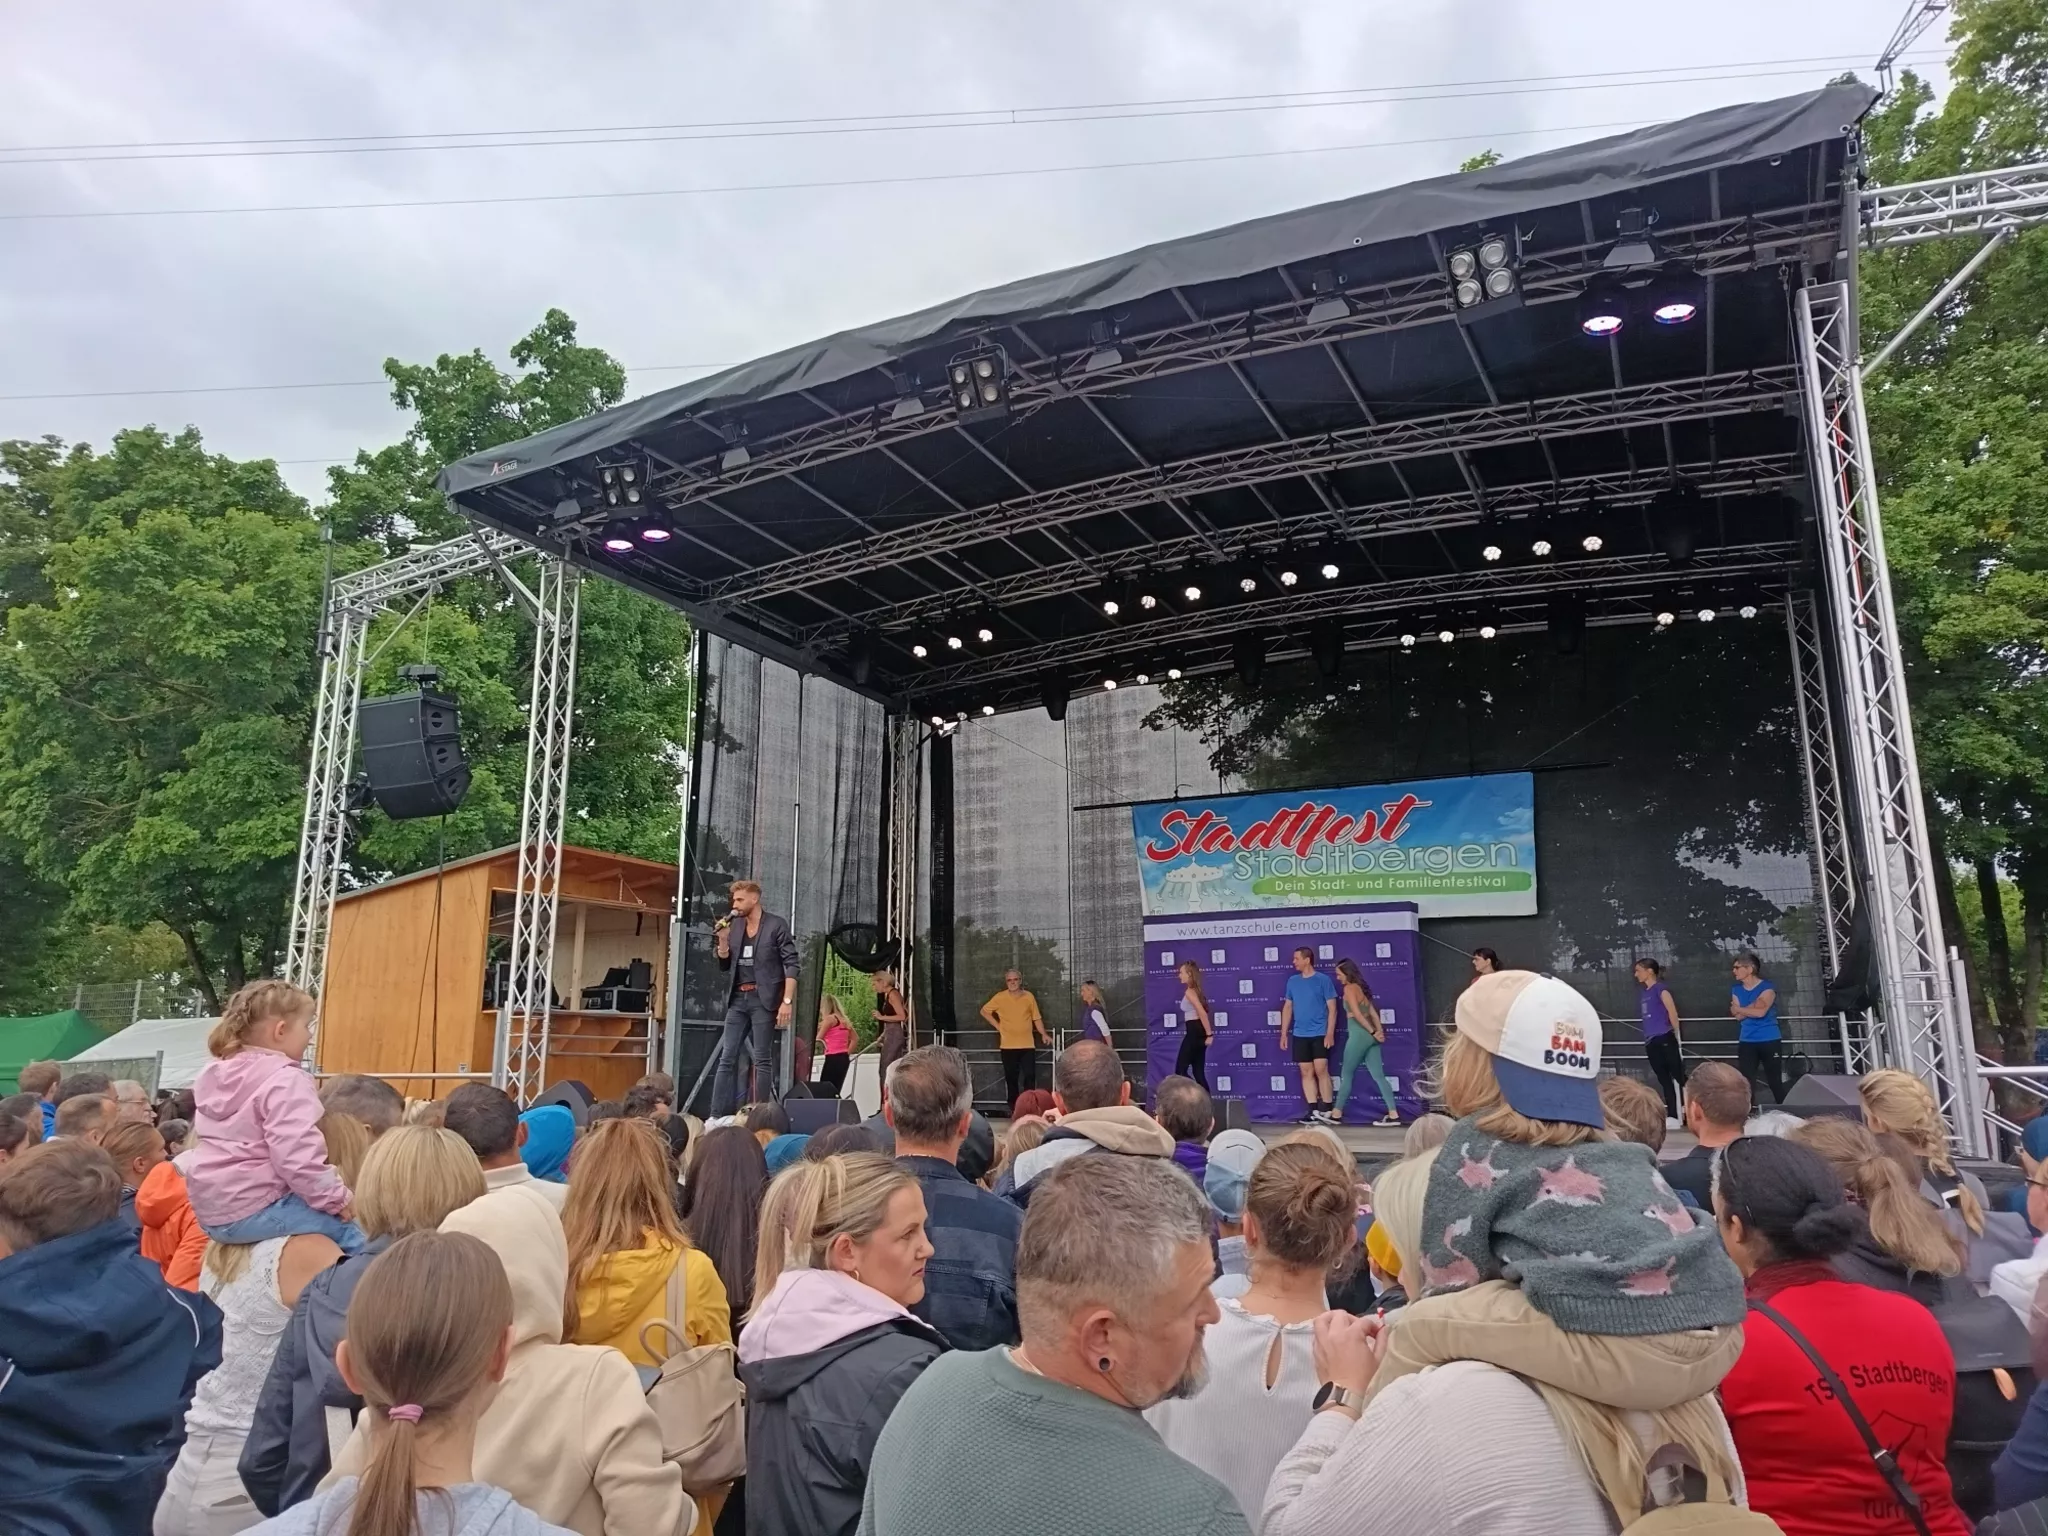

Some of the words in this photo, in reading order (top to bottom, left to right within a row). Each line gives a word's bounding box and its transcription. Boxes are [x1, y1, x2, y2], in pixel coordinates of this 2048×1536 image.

[1146, 793, 1433, 862] Stadtfest
[1233, 842, 1517, 880] Stadtbergen
[1275, 880, 1304, 891] Dein
[1310, 878, 1351, 891] Stadt-
[1357, 877, 1383, 889] und
[1389, 875, 1506, 889] Familienfestival
[1177, 917, 1370, 936] www.tanzschule-emotion.de
[1551, 1035, 1586, 1054] BAM
[1544, 1049, 1590, 1070] BOOM
[1849, 1359, 1949, 1397] Stadtbergen
